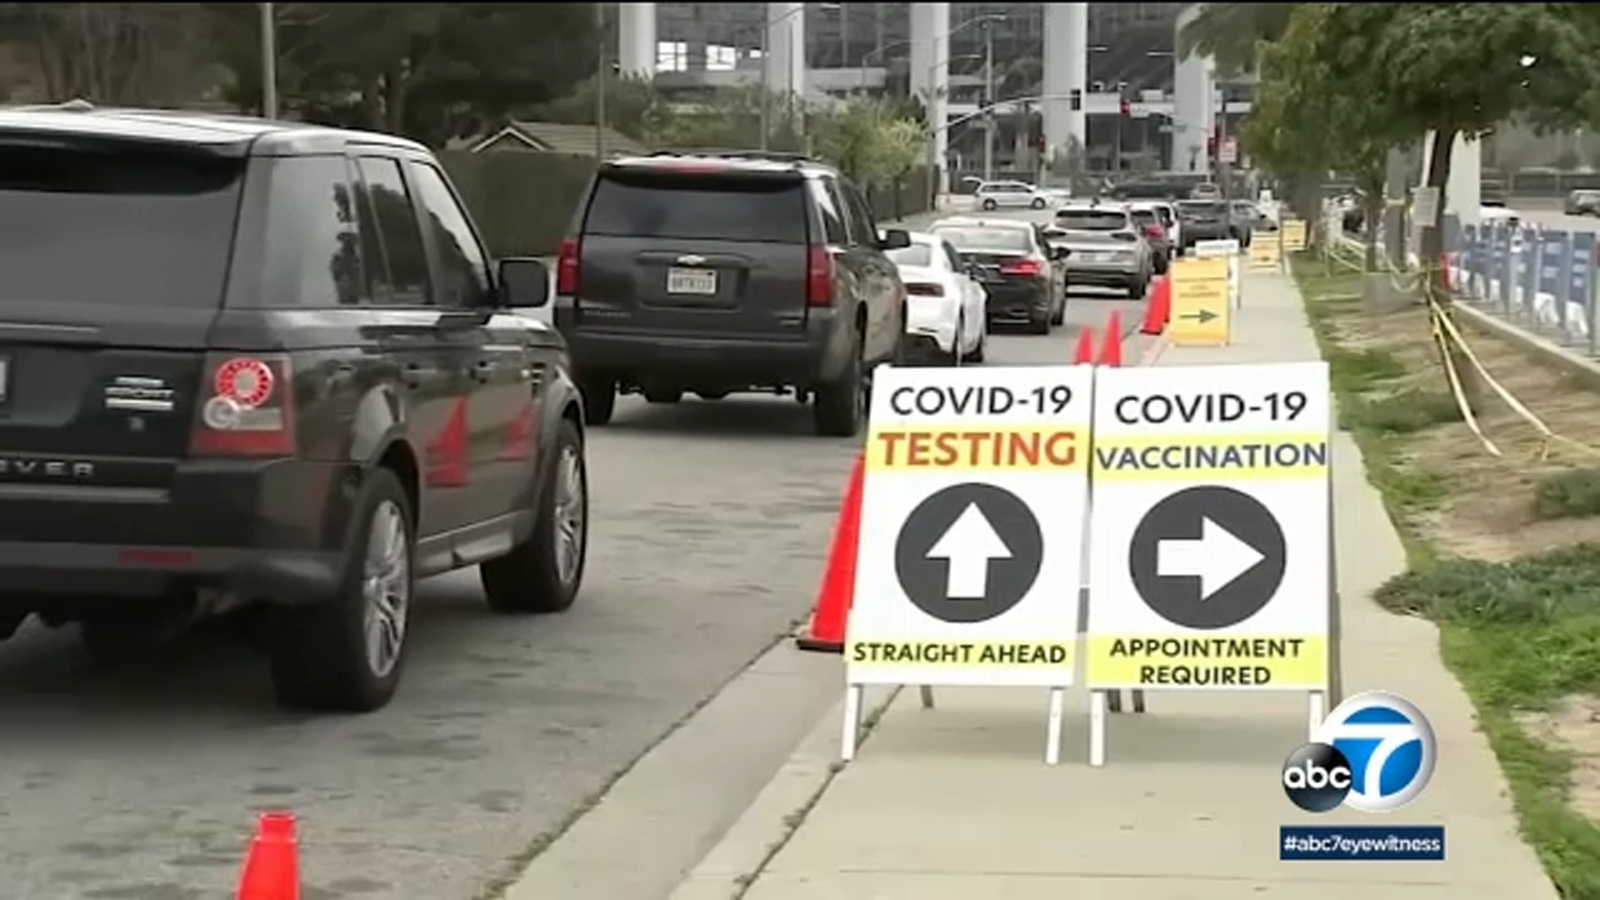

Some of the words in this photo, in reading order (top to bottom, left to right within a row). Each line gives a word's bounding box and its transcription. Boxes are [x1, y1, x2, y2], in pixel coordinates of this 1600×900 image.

[890, 386, 1073, 416] COVID-19
[1115, 392, 1308, 425] COVID-19
[878, 432, 1078, 468] TESTING
[1096, 442, 1327, 471] VACCINATION
[853, 642, 973, 664] STRAIGHT
[979, 645, 1067, 664] AHEAD
[1109, 638, 1304, 658] APPOINTMENT
[1139, 665, 1272, 686] REQUIRED
